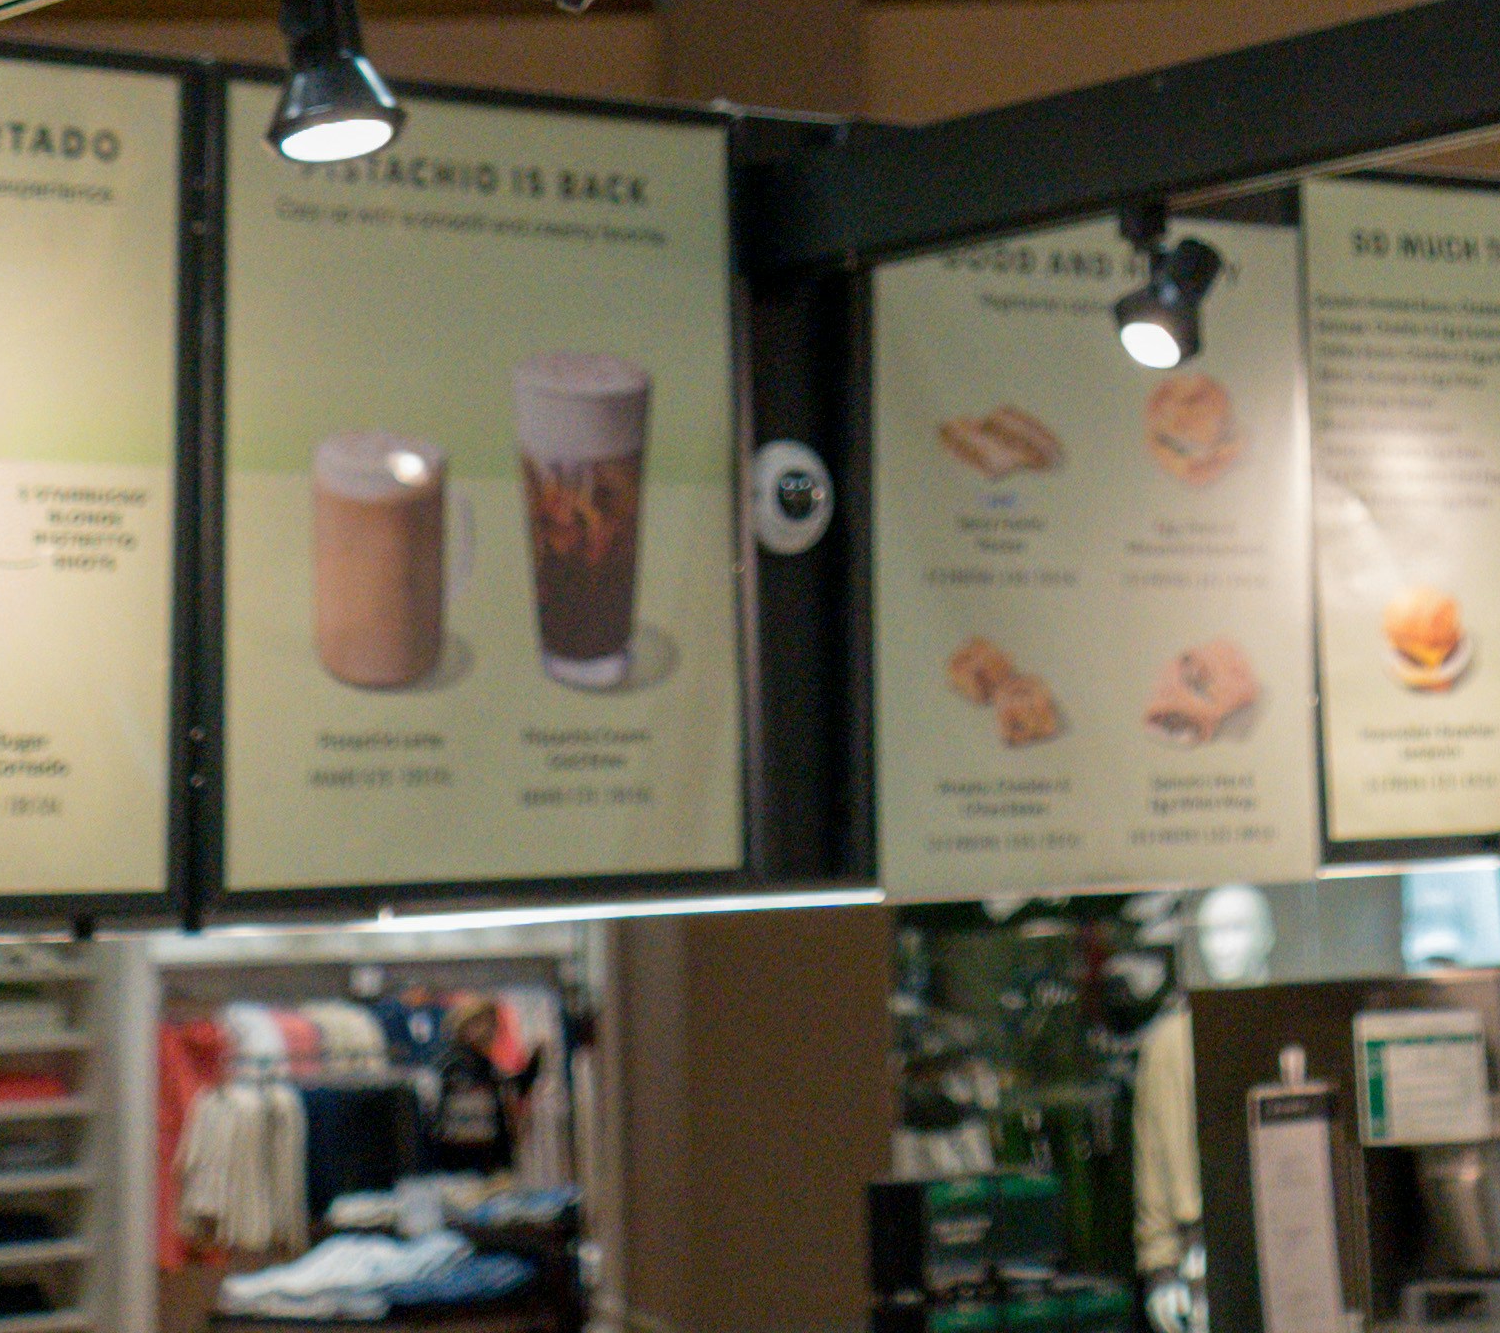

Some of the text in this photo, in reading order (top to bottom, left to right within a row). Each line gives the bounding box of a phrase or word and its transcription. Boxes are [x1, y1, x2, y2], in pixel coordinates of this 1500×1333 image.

[511, 164, 545, 200] IS
[557, 168, 647, 206] BACK
[1352, 228, 1389, 258] SO
[1398, 231, 1479, 265] MUCH
